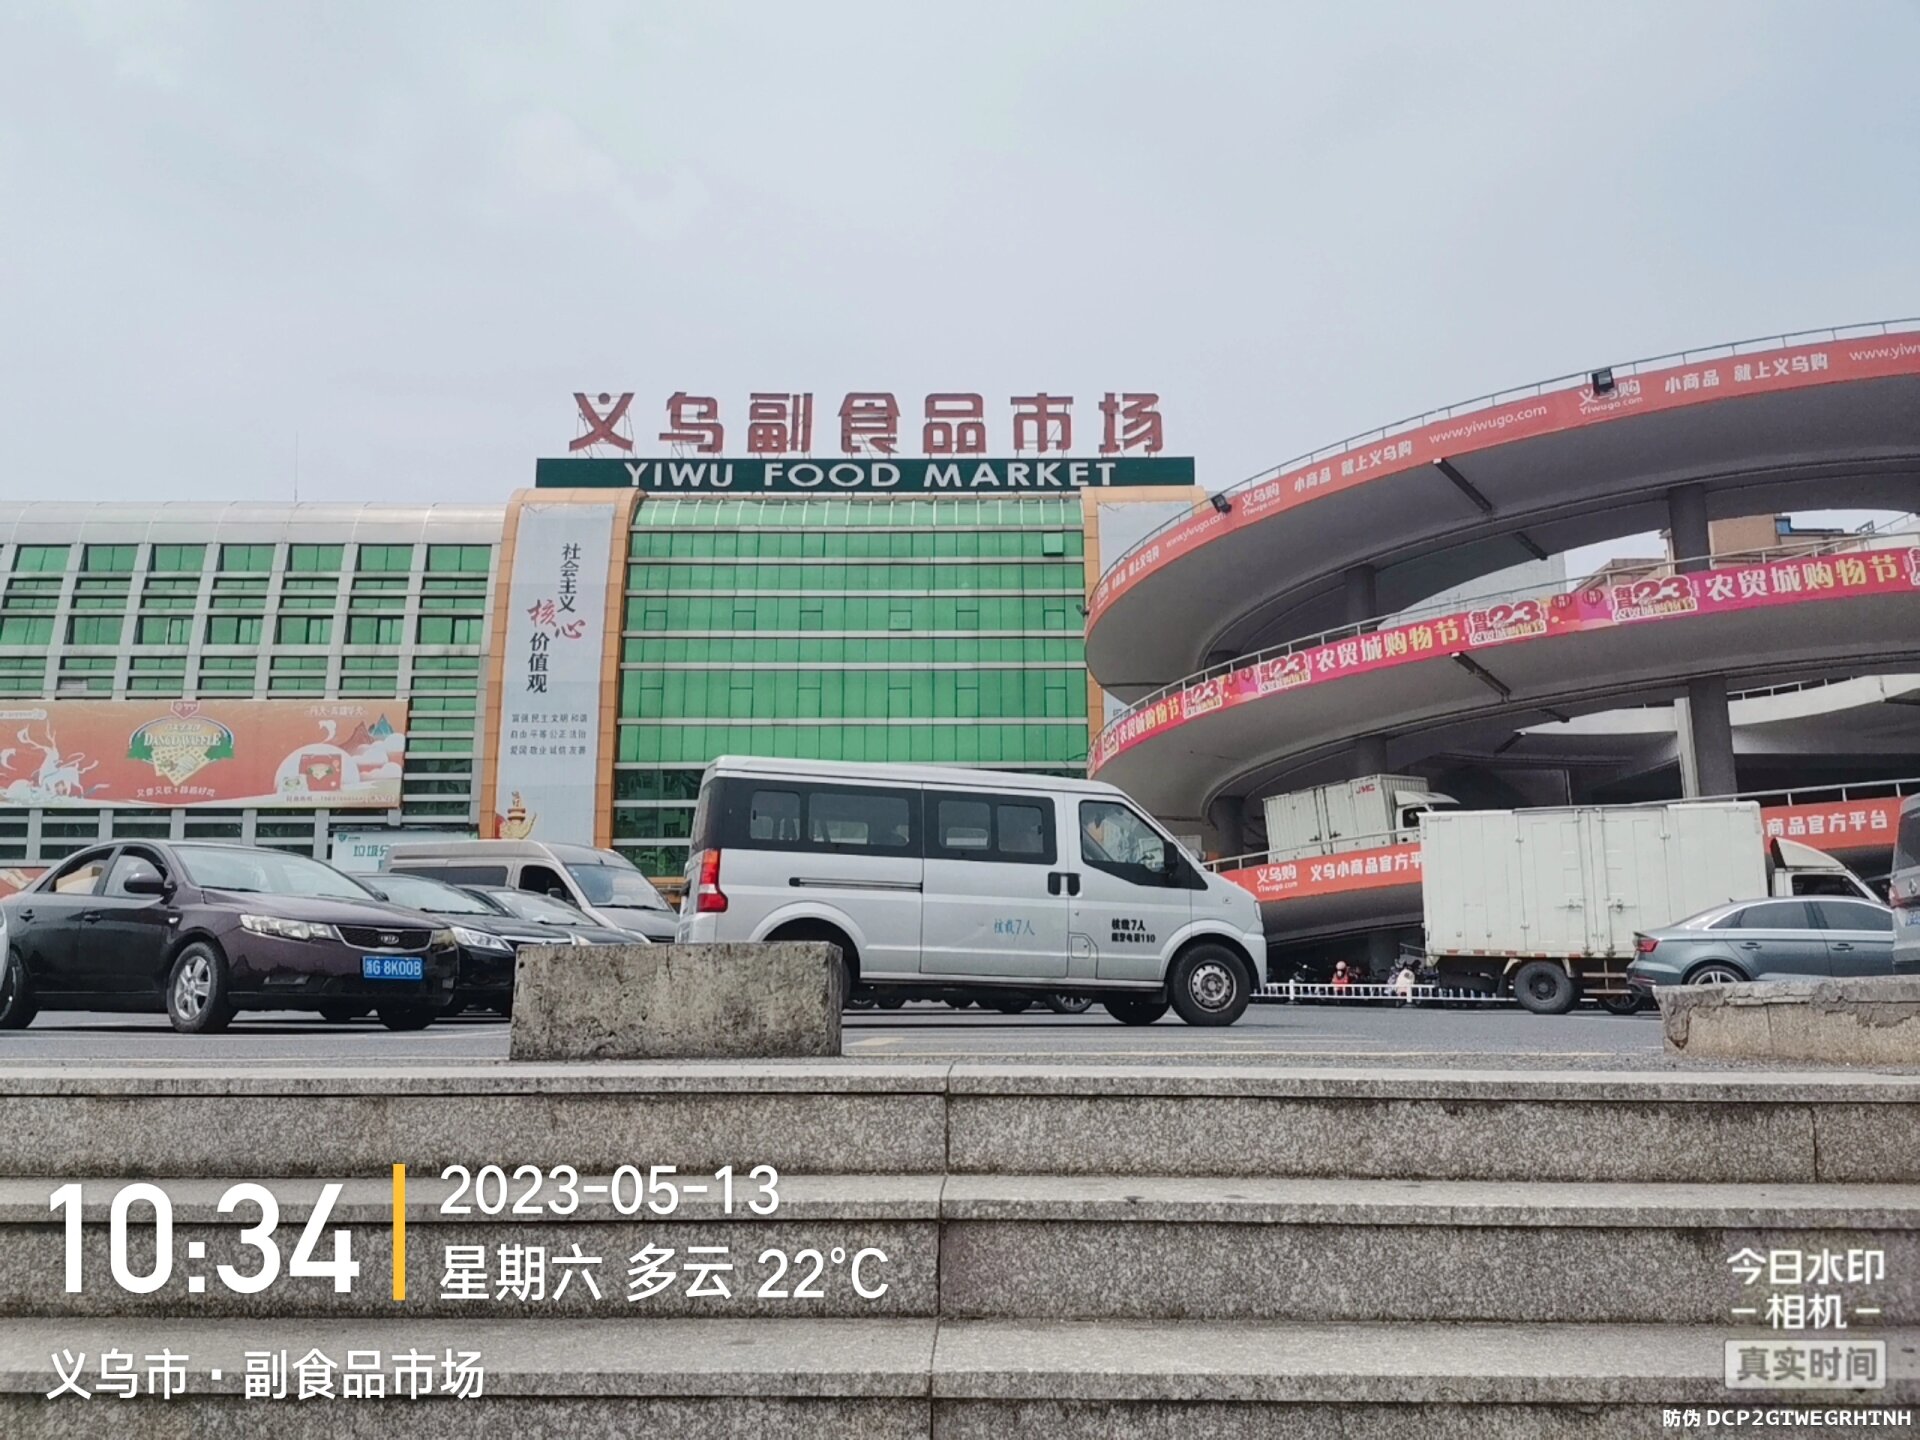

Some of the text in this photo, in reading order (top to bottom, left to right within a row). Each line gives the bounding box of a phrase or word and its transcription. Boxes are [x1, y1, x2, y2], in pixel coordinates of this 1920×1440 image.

[1848, 342, 1920, 361] www.yiw
[1664, 352, 1829, 394] 小商品 就上义乌购
[569, 391, 1163, 453] 义乌副食品市场
[1428, 404, 1548, 445] www.yiwugo.com
[1579, 396, 1644, 416] Yiwugo.com
[624, 461, 1117, 488] YIWU FOOD MARKET
[1293, 439, 1413, 494] 小商品 就上义乌购
[1242, 483, 1280, 510] 义乌购
[556, 542, 582, 613] 社会主义
[1704, 553, 1898, 602] 农贸城购物节
[527, 598, 587, 640] 核心
[526, 631, 551, 694] 价值观
[1316, 620, 1459, 673] 农贸城购物节
[1762, 810, 1888, 837] 商品官方平台
[1257, 864, 1297, 885] 义乌购
